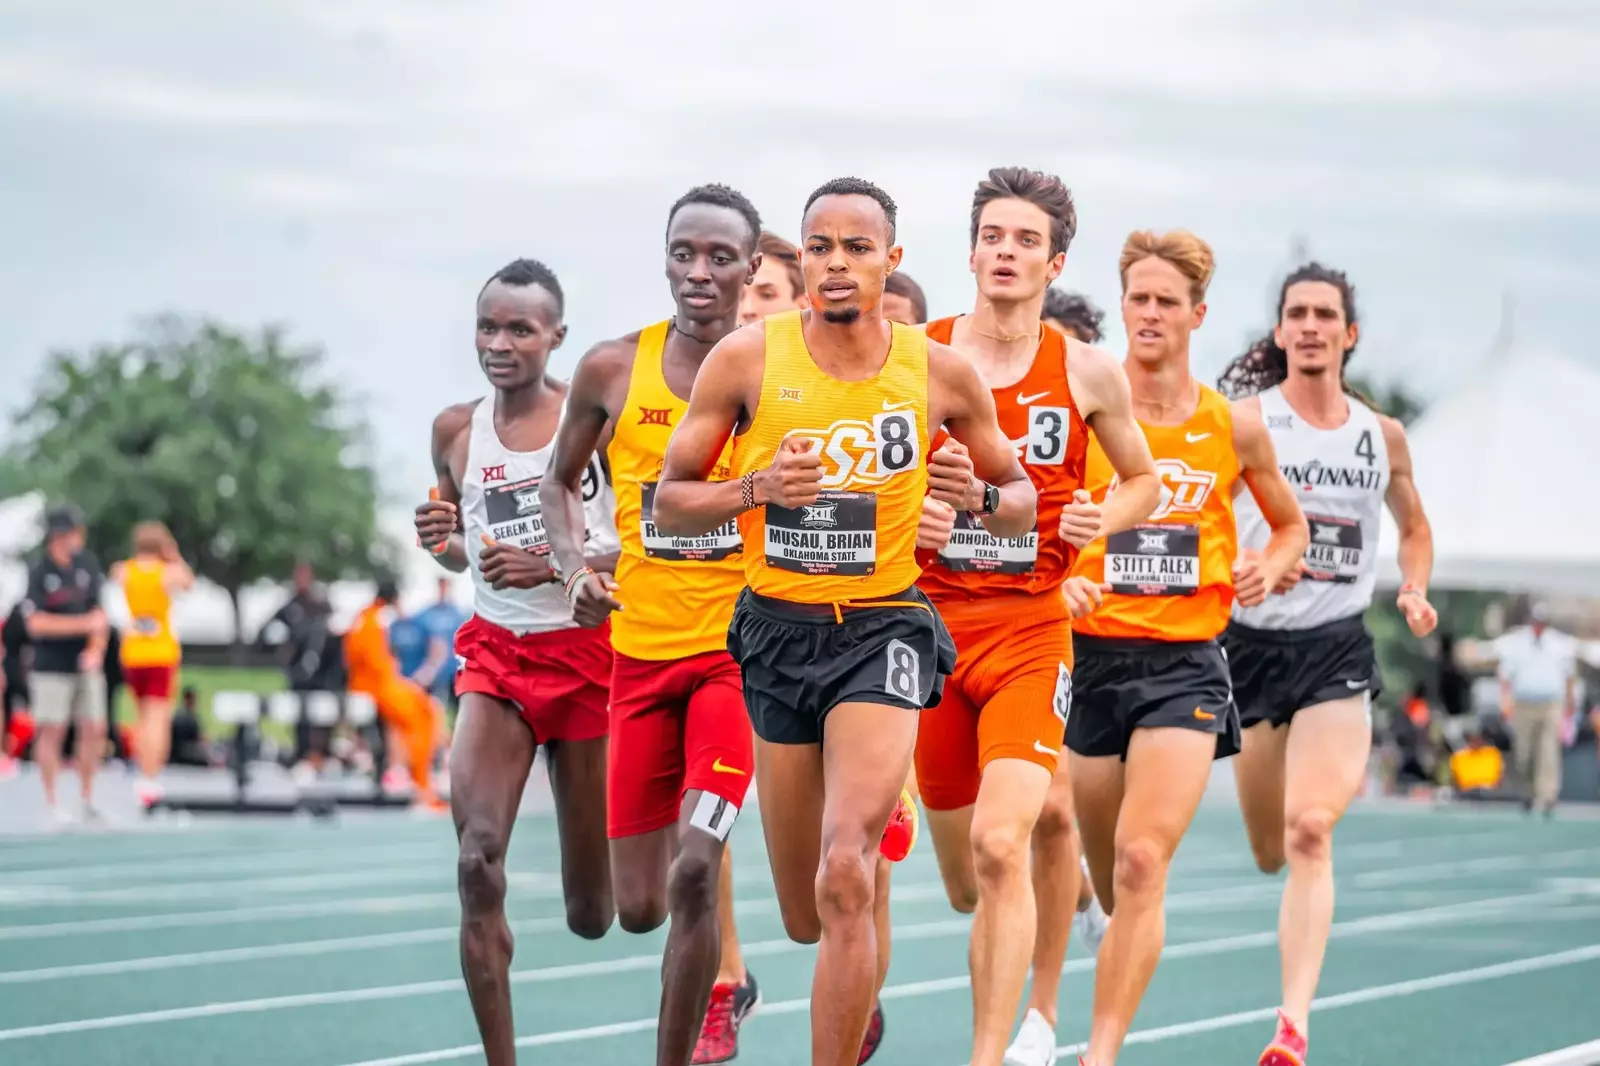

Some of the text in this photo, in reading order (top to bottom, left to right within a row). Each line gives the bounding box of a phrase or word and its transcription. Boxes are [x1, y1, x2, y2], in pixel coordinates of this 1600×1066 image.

[637, 406, 673, 427] XII
[880, 415, 914, 470] 8
[1033, 411, 1062, 460] 3
[1355, 429, 1376, 467] 4
[481, 464, 507, 483] XII
[1280, 462, 1381, 490] INCINNATI
[801, 504, 838, 523] XII
[671, 538, 719, 548] IOWA STATE
[769, 528, 872, 550] MUSAU, BRIAN
[1008, 535, 1035, 548] COLE
[783, 548, 857, 562] OKLAHOMA STATE
[974, 549, 999, 558] TEXAS
[1160, 558, 1192, 575] ALEX
[891, 647, 915, 698] 8
[1057, 671, 1072, 718] 3
